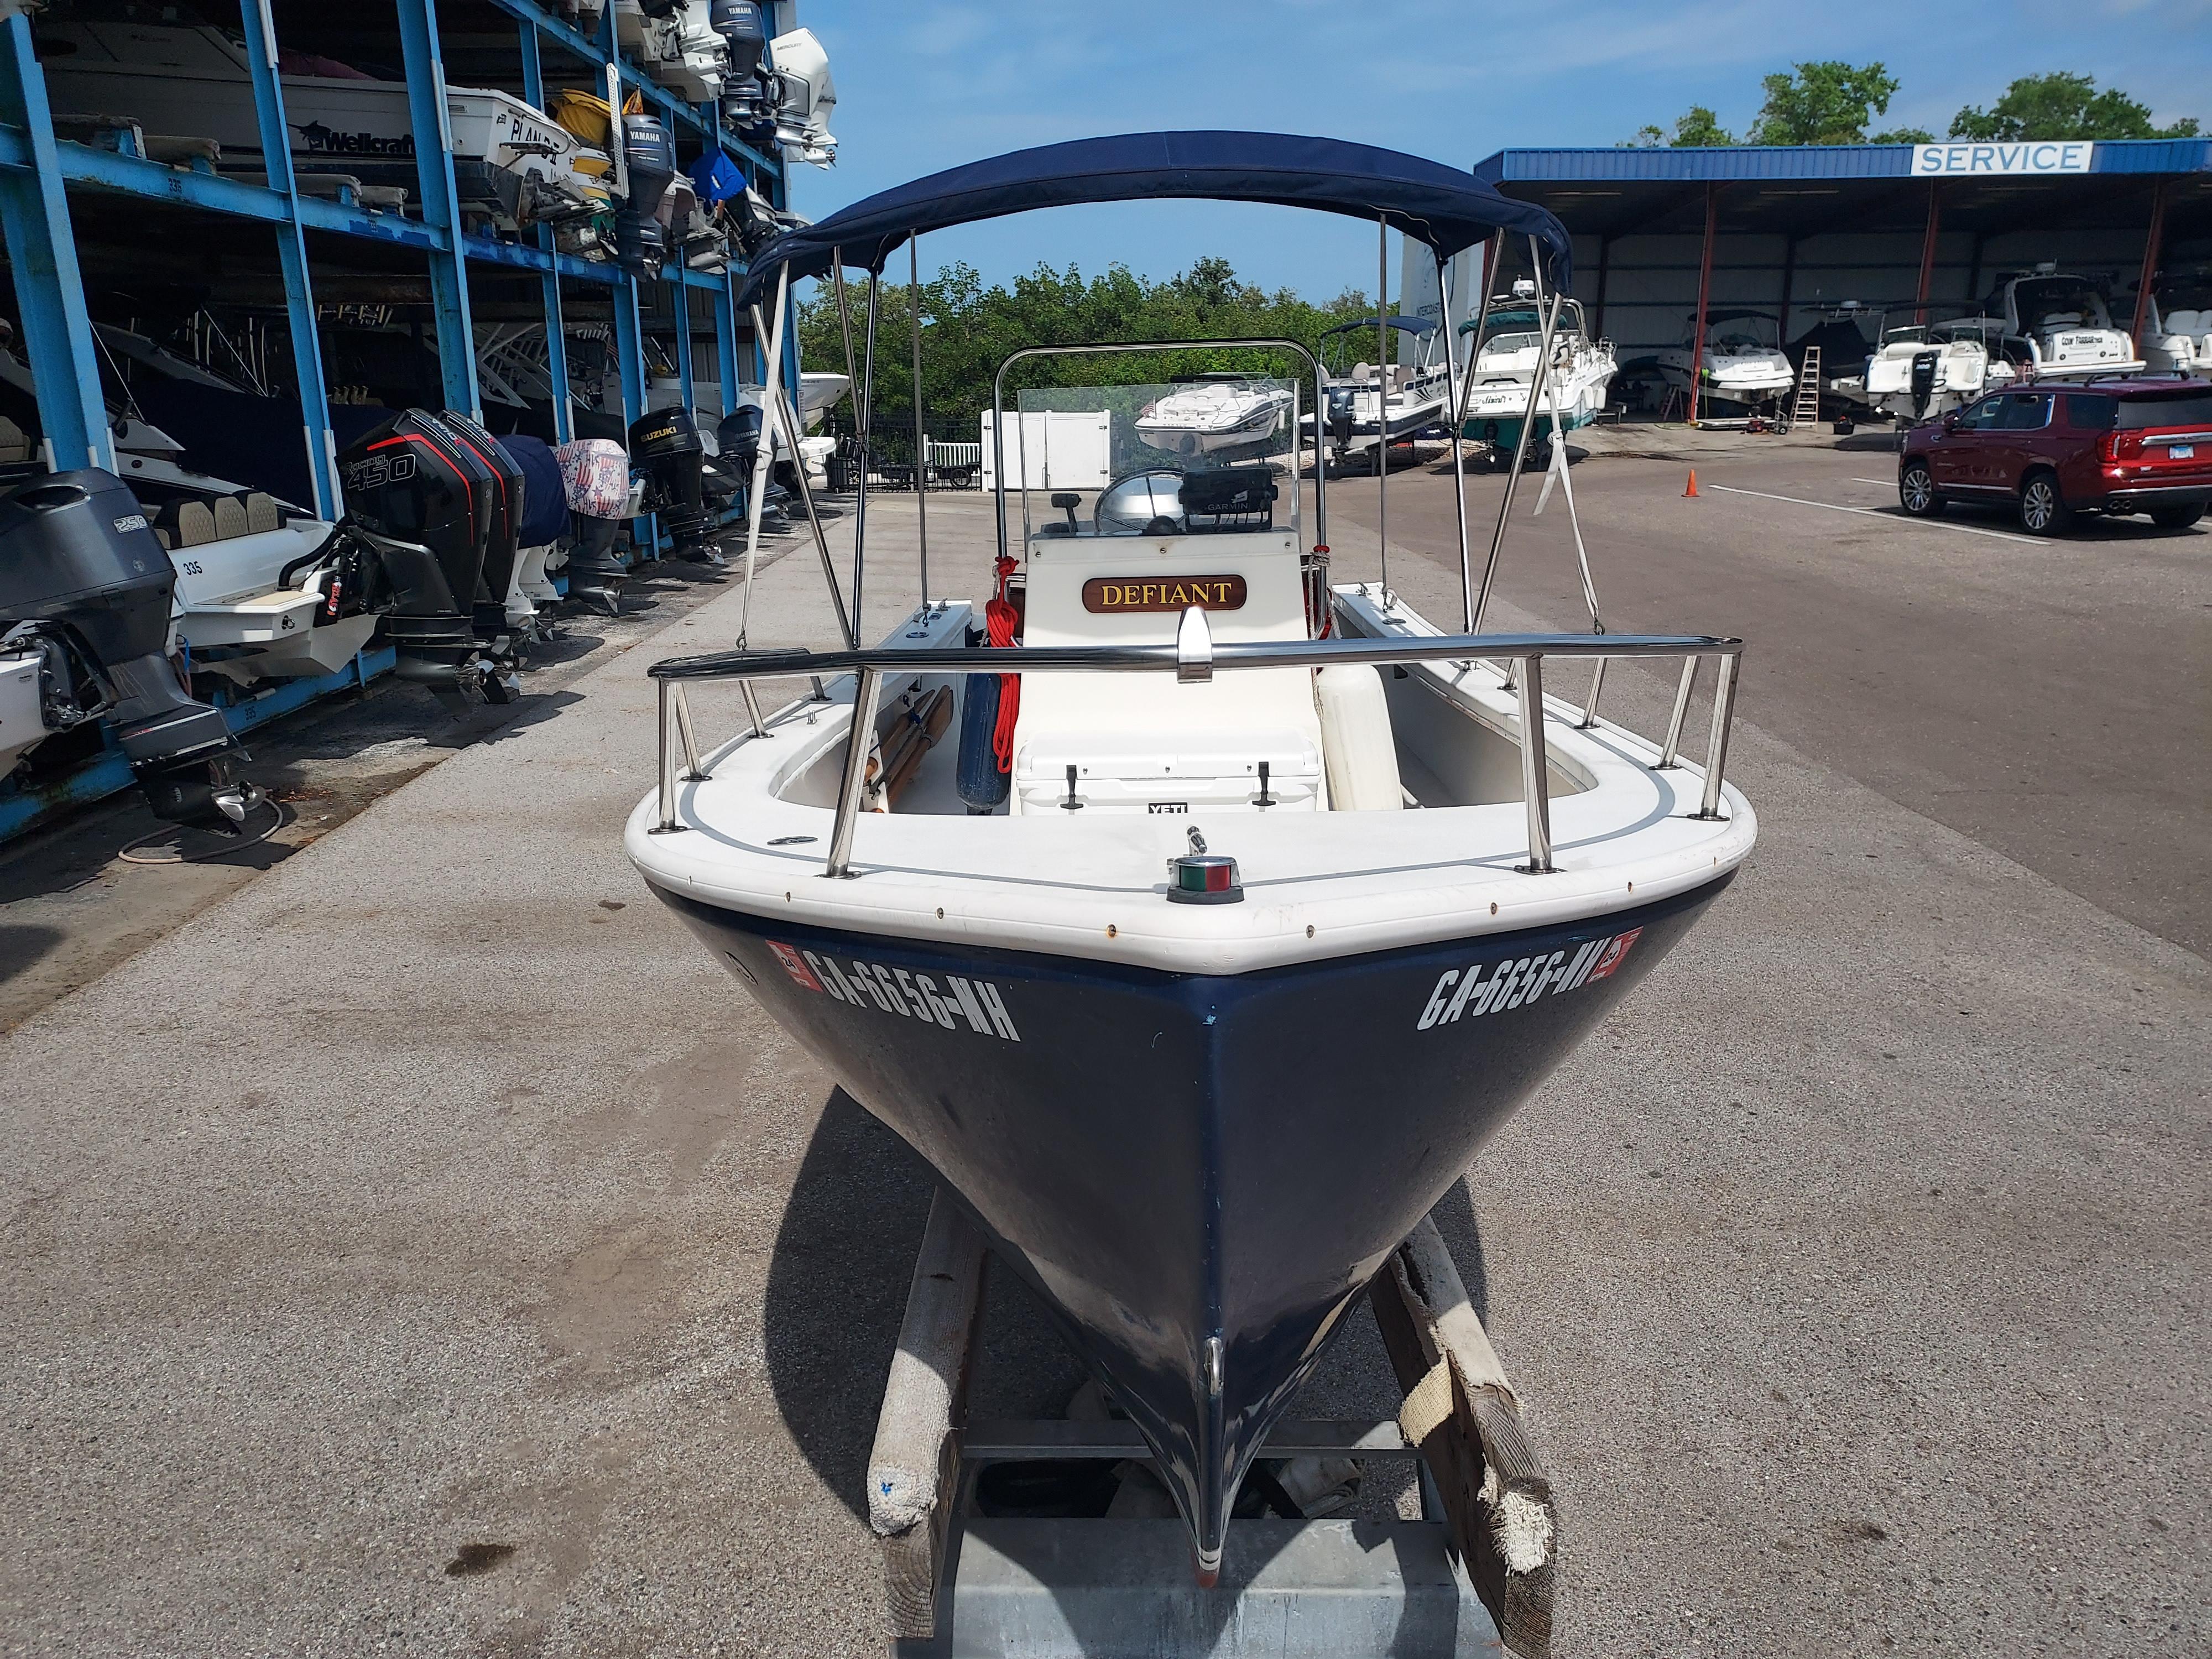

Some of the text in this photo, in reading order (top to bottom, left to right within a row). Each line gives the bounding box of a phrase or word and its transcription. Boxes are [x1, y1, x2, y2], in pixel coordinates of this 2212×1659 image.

[777, 43, 802, 51] MERCURY
[630, 131, 660, 143] YAMAHA
[1921, 145, 2083, 171] SERVICE
[640, 426, 677, 442] SUZUKI
[739, 429, 759, 439] YAMAHA
[348, 454, 416, 491] 450
[114, 515, 148, 533] 250
[183, 561, 202, 576] 335
[1101, 583, 1232, 605] DEFIANT
[1150, 805, 1186, 813] YETI
[781, 957, 797, 969] 24
[1603, 950, 1619, 963] 24
[1417, 936, 1613, 1031] GA-6656-NH
[802, 950, 1021, 1042] GA-6656-NH
